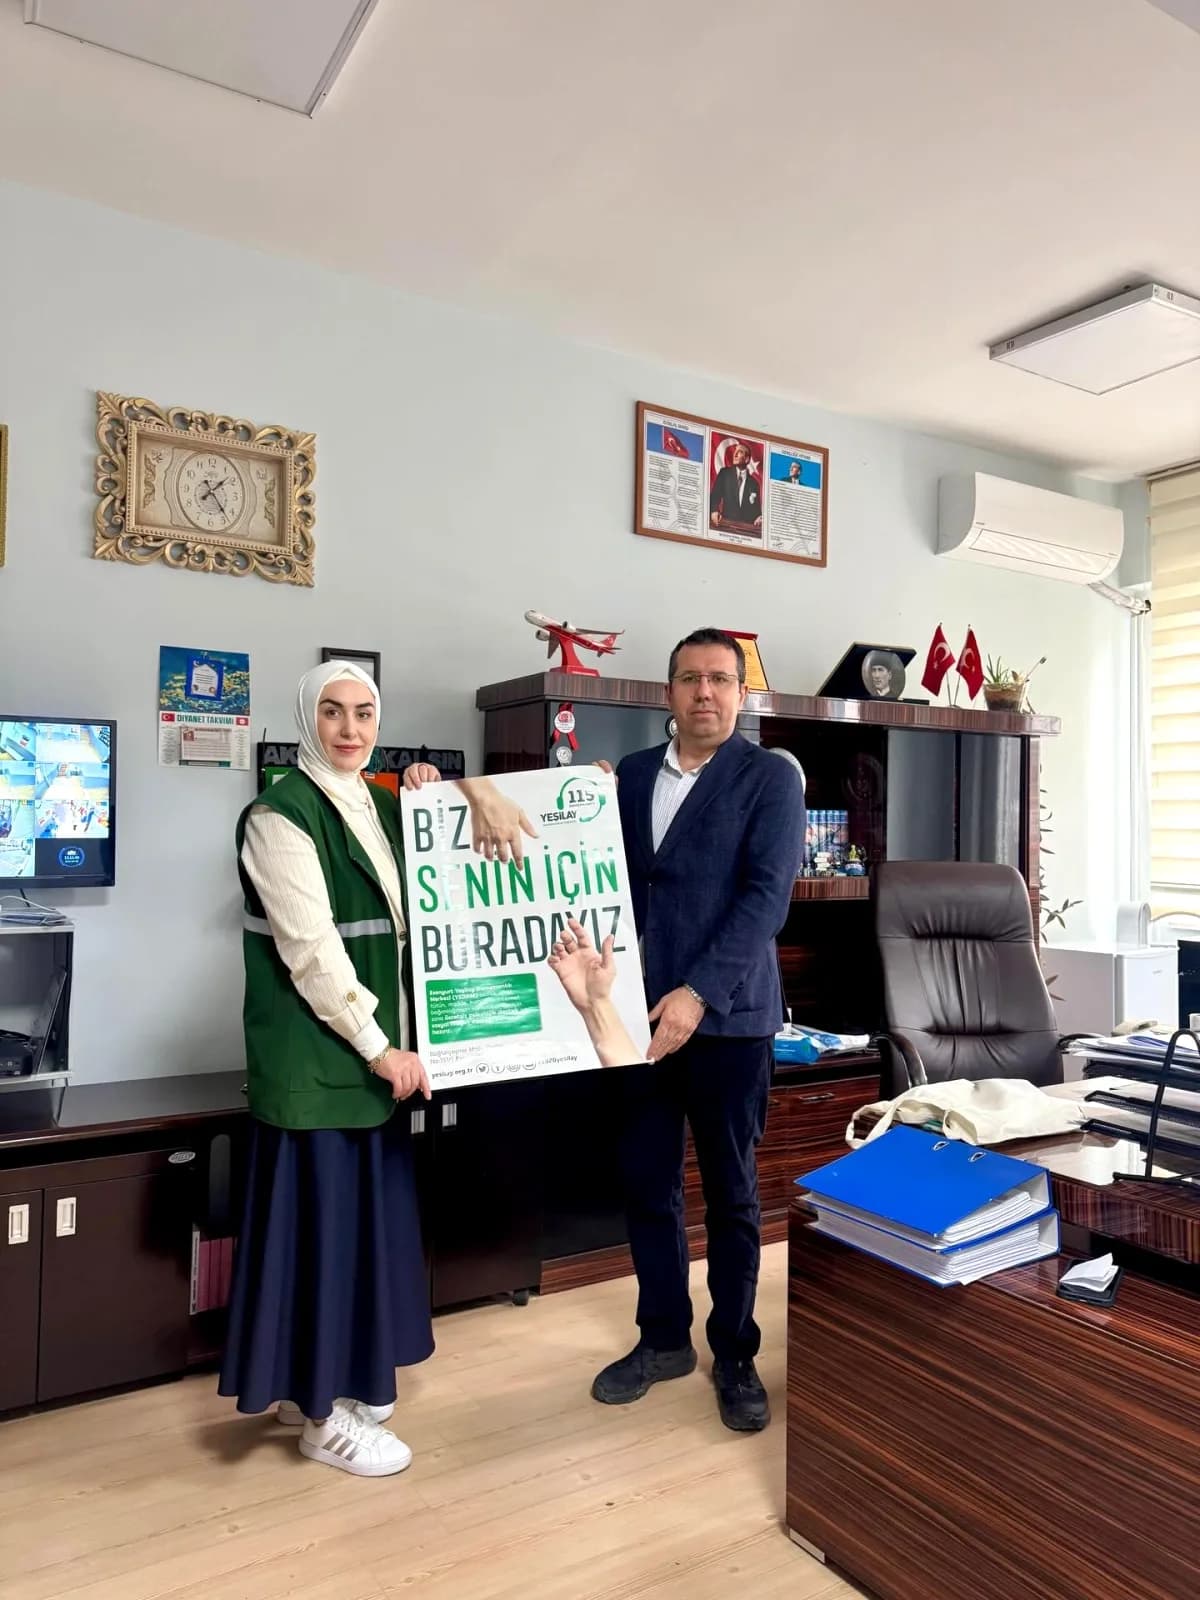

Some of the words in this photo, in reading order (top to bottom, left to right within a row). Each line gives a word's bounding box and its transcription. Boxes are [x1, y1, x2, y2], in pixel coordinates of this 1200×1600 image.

[568, 789, 595, 803] 115
[413, 799, 470, 852] BİZ
[544, 841, 619, 905] İÇİN
